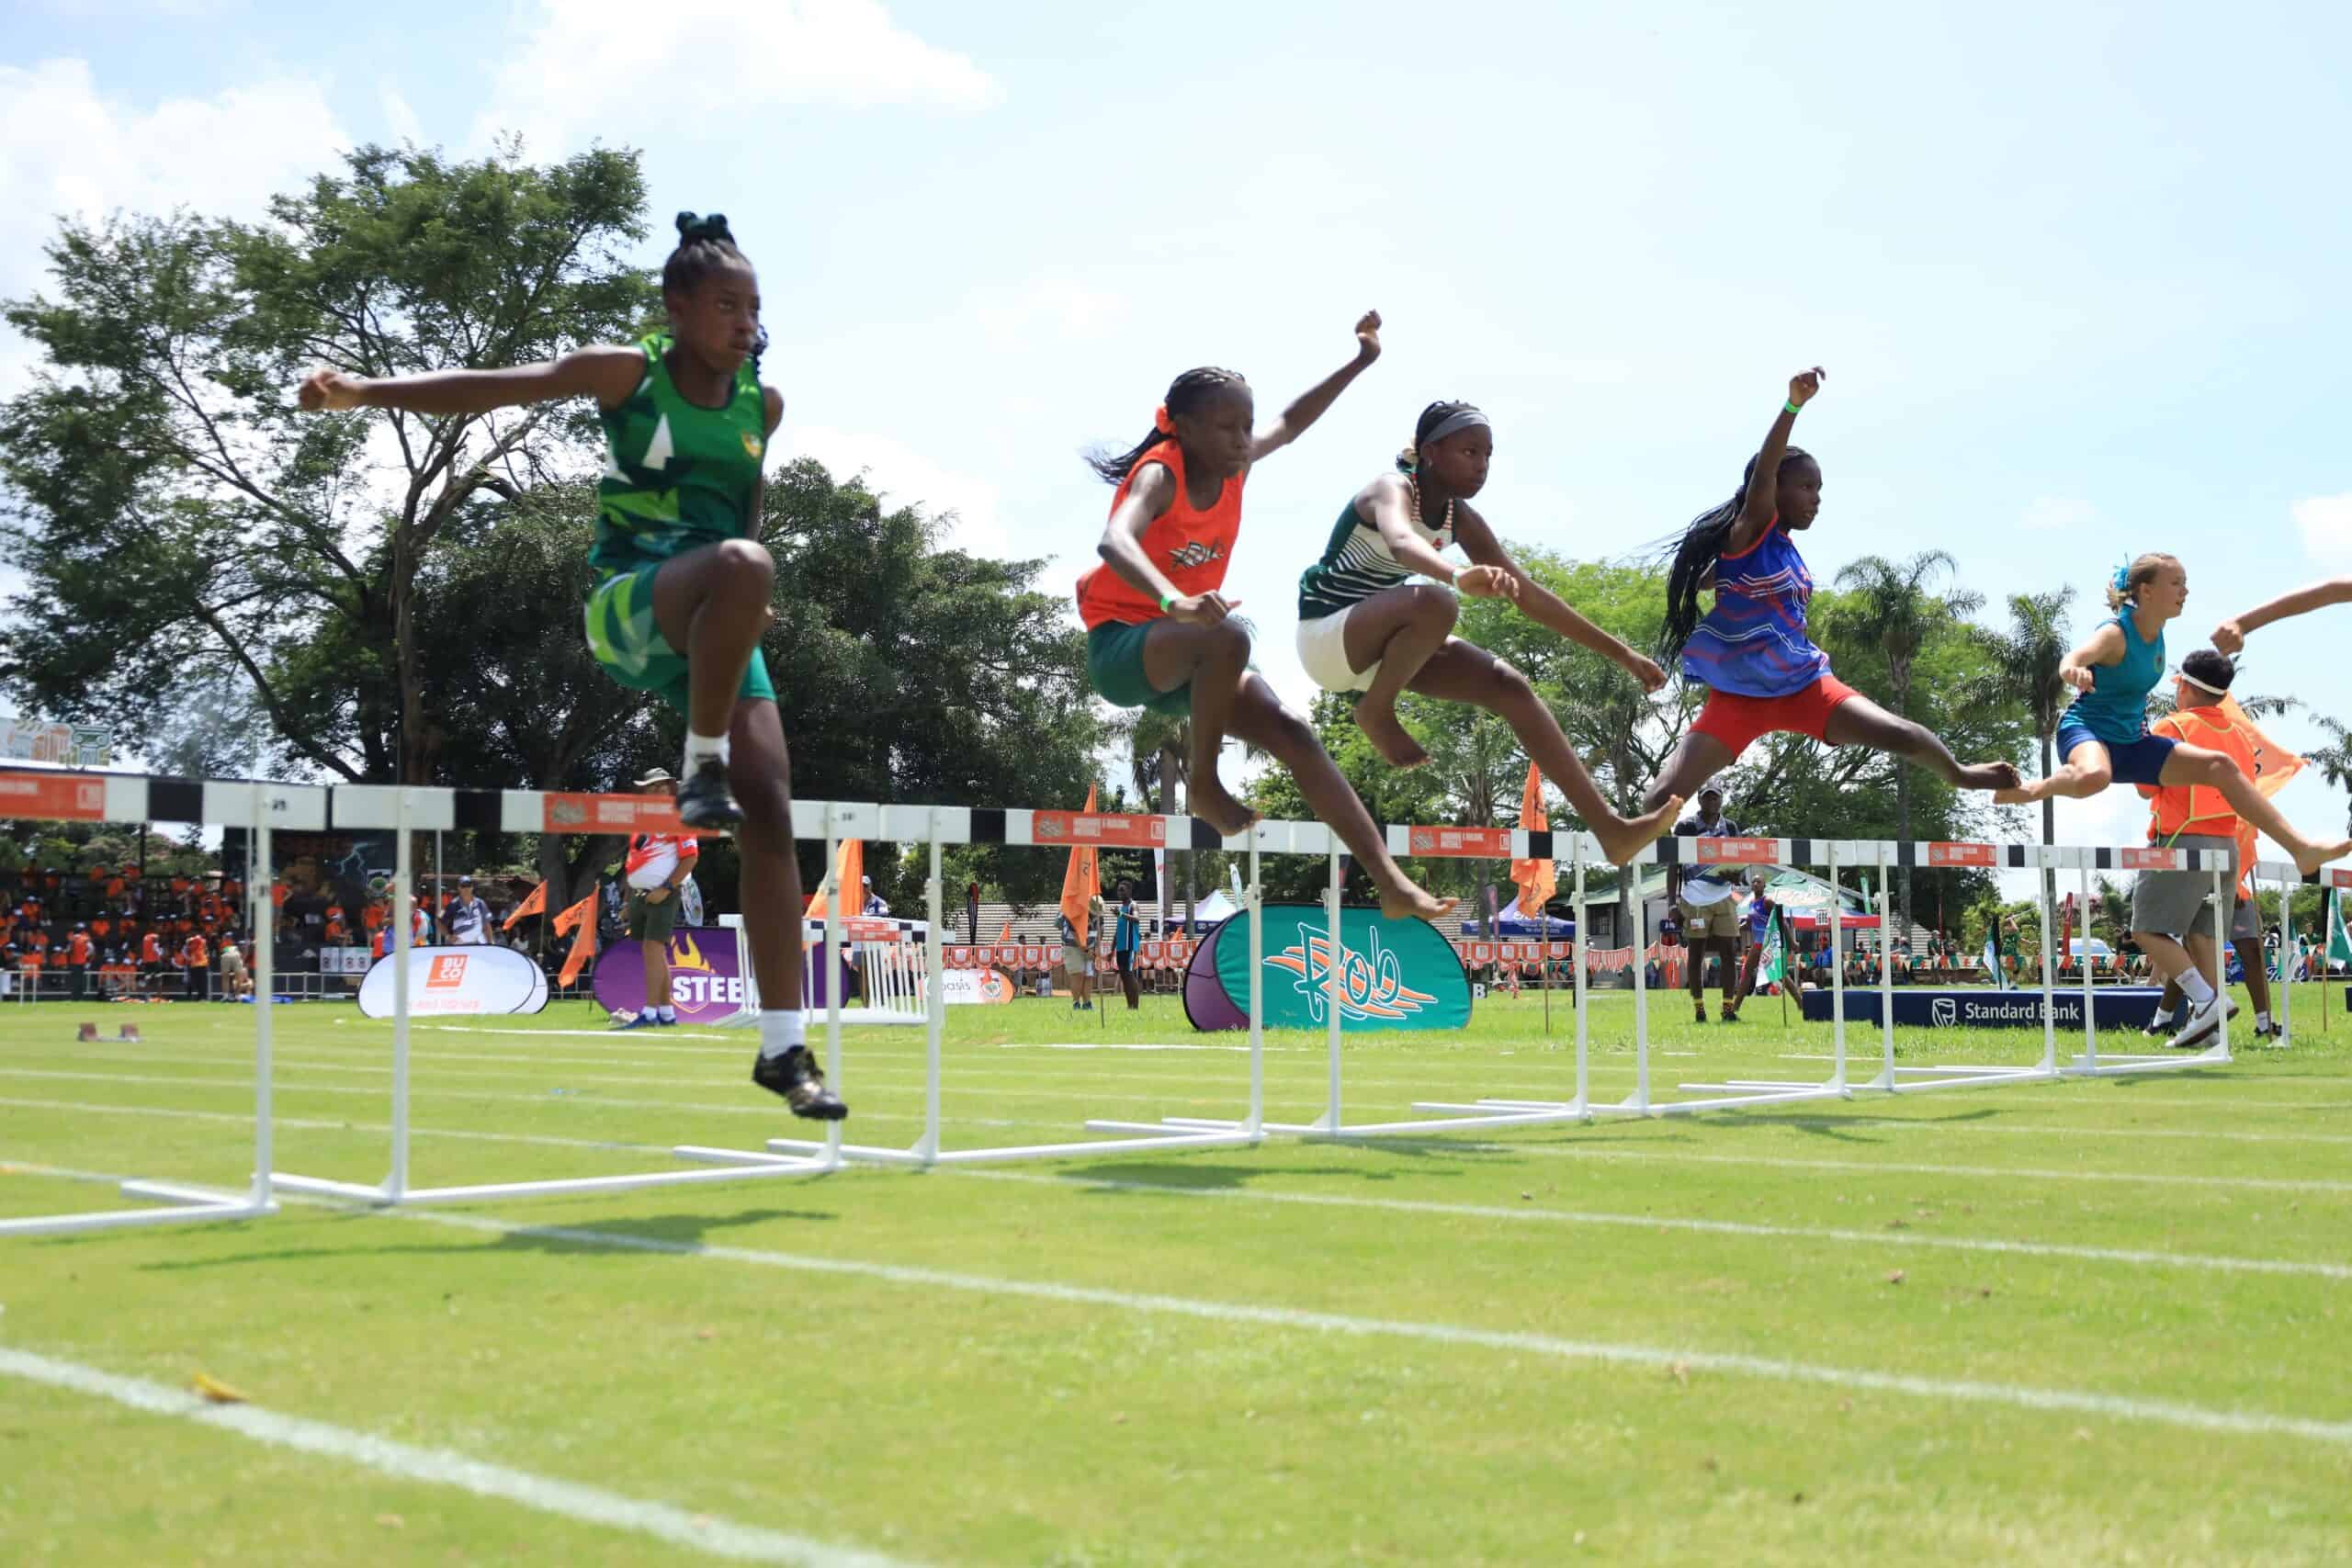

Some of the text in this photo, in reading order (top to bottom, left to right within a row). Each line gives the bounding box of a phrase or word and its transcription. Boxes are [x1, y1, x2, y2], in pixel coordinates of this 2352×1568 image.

[1294, 921, 1402, 1022] Rob
[673, 976, 755, 1003] STEE
[1473, 983, 1486, 999] B
[1965, 1001, 2035, 1020] Standard
